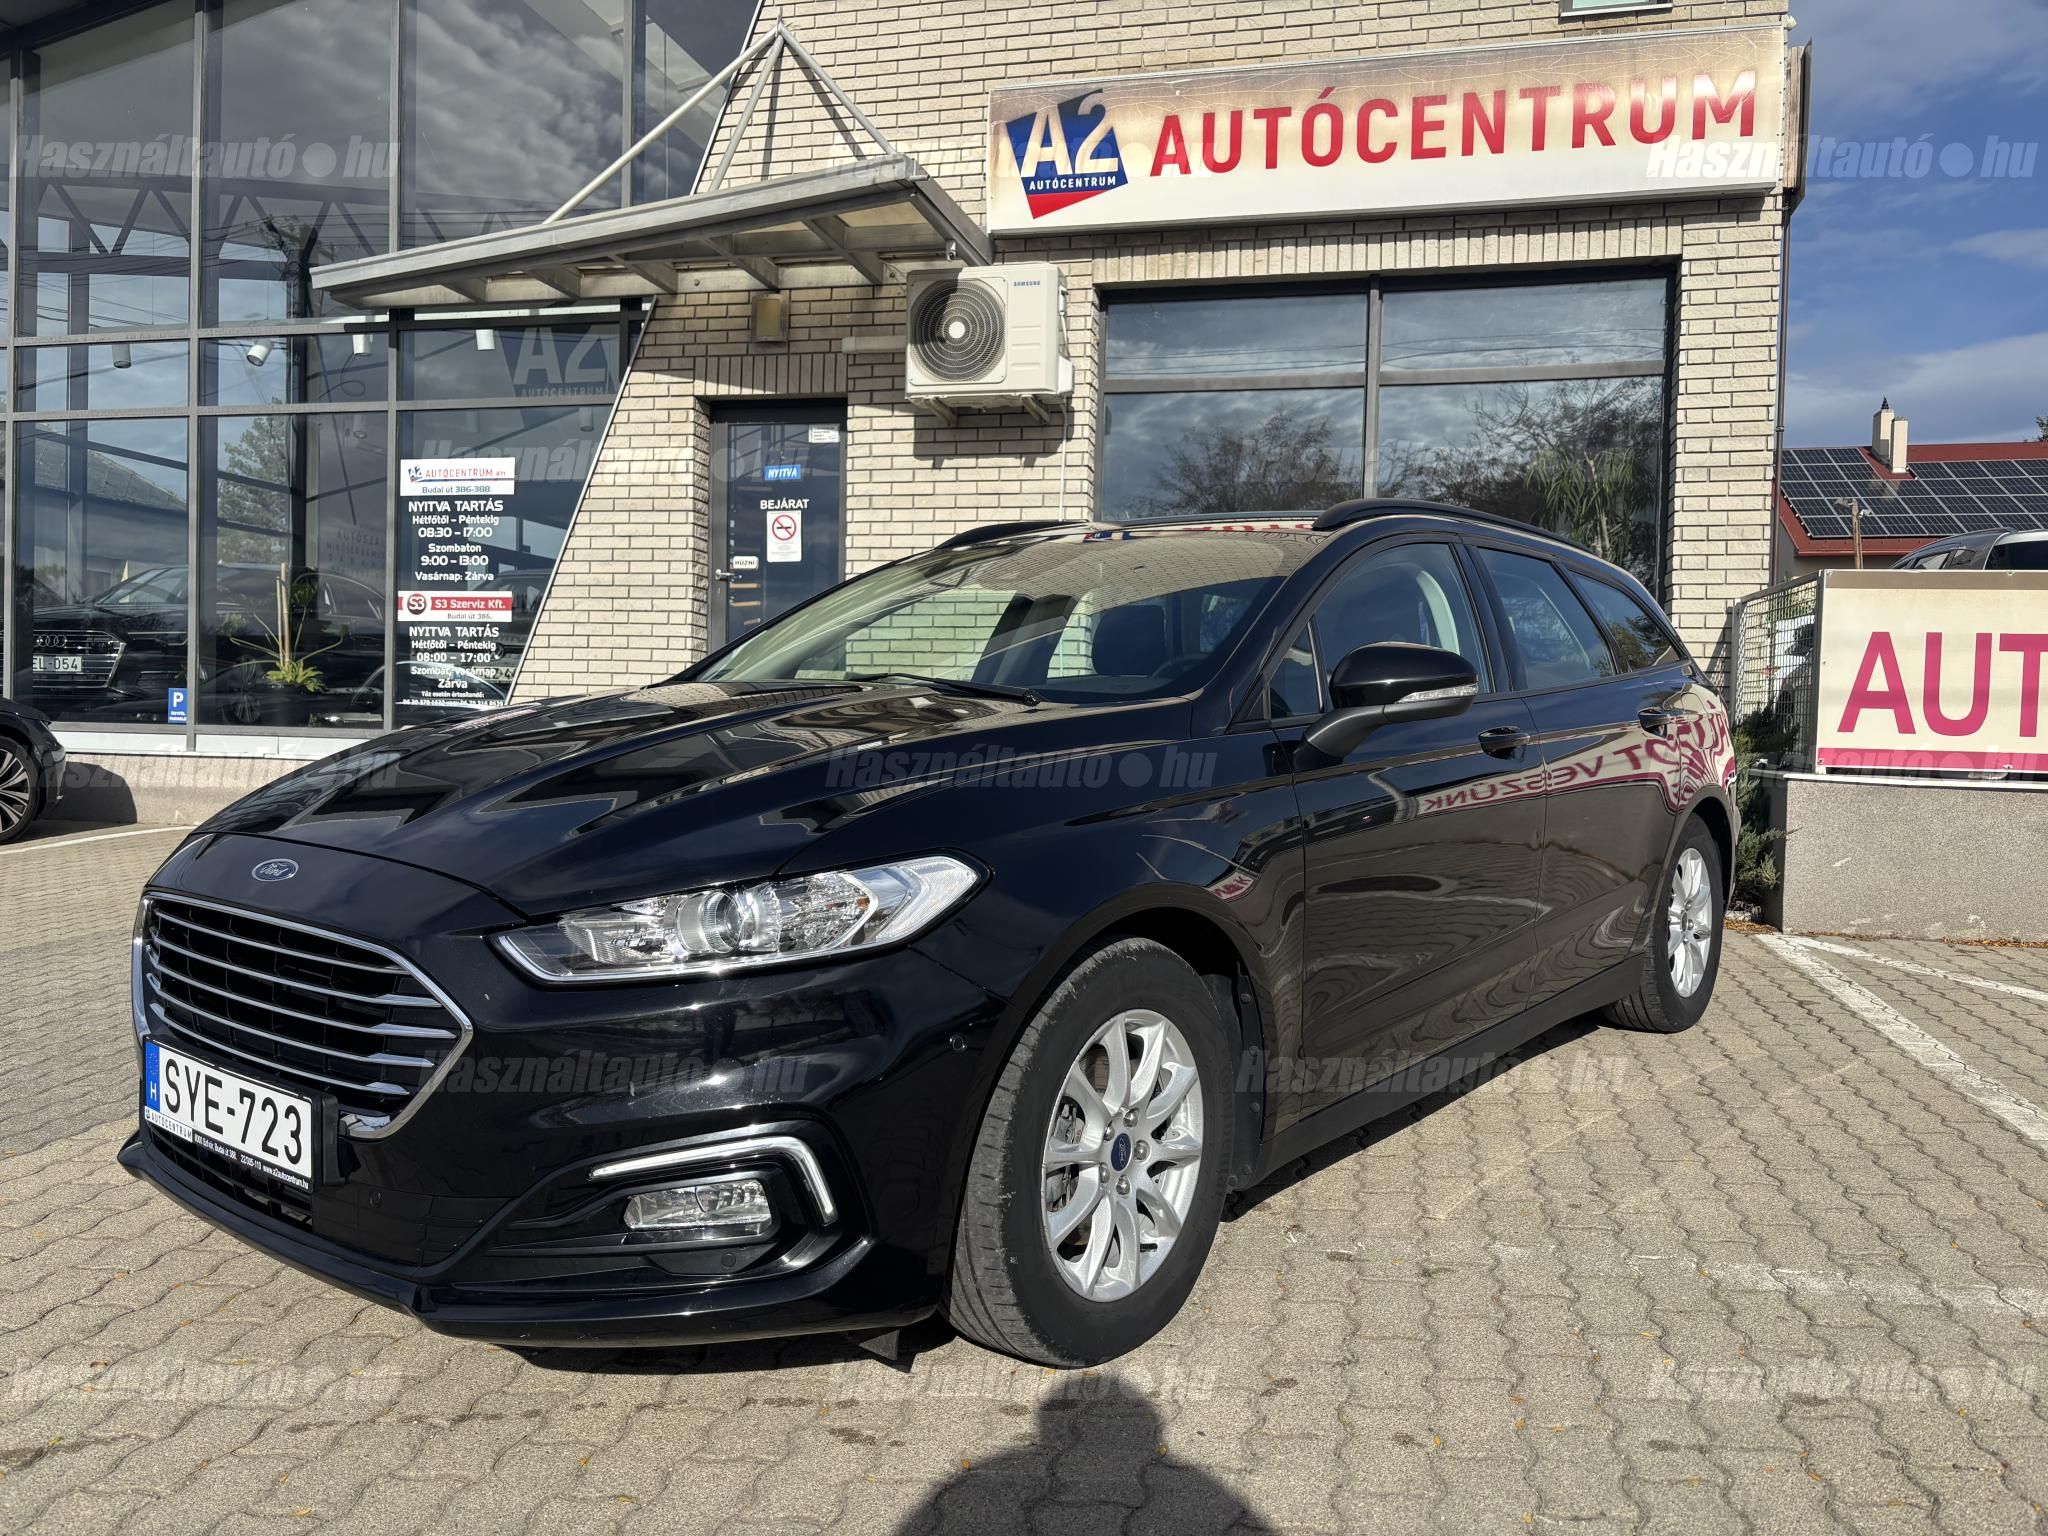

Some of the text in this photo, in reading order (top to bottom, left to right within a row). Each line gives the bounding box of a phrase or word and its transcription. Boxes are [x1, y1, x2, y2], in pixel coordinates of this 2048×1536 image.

[1149, 69, 1756, 177] AUTÓCENTRUM
[1020, 92, 1119, 177] A2
[1029, 175, 1116, 190] AUTÓCENTRUM
[425, 467, 493, 478] AUTÓCENTRUM
[768, 467, 797, 479] NYITVA
[408, 498, 504, 512] NYITVA TARTÁS
[760, 497, 810, 510] BEJÁRAT
[412, 515, 449, 525] Hétfőtől
[458, 515, 499, 526] Péntekig
[418, 527, 452, 538] 08:30
[463, 527, 493, 538] 17:00
[428, 543, 482, 553] Szombaton
[420, 555, 449, 566] 9:00
[459, 555, 489, 566] 13:00
[415, 571, 495, 582] Vasárnap: Zárva
[407, 596, 426, 611] S3
[435, 598, 506, 609] S3 Szerviz Kft.
[409, 624, 500, 637] NYITVA TARTÁS
[411, 640, 447, 649] Hétfőtől
[457, 640, 497, 652] Péntekig
[416, 652, 447, 662] 08:00
[460, 652, 491, 663] 17:00
[437, 678, 468, 689] Zárva
[173, 691, 184, 707] P
[149, 1080, 157, 1102] H
[164, 1058, 302, 1165] SYE-723
